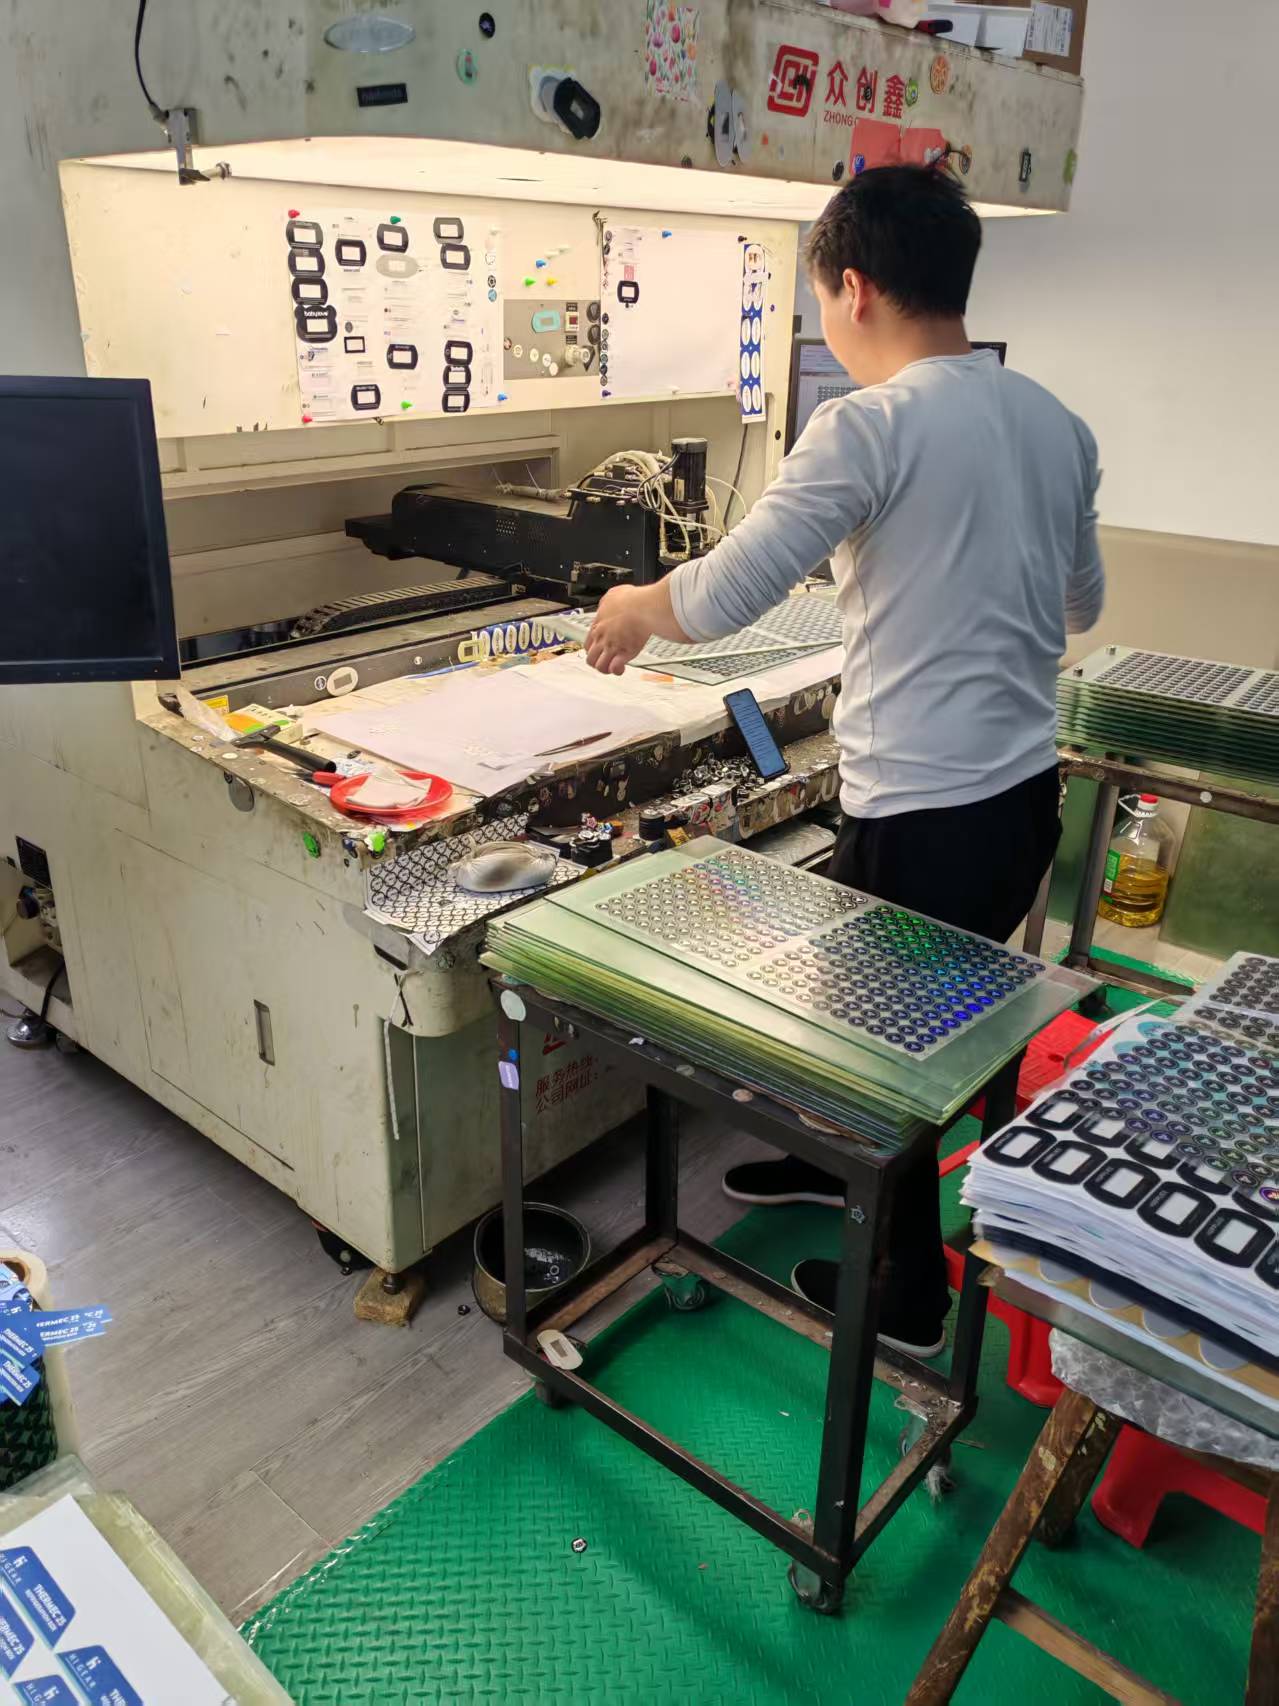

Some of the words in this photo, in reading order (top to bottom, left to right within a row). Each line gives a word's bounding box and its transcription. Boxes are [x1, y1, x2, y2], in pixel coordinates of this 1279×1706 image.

[825, 60, 905, 119] 众创鑫
[824, 111, 853, 126] ZHONG
[33, 1584, 62, 1618] THERMEC
